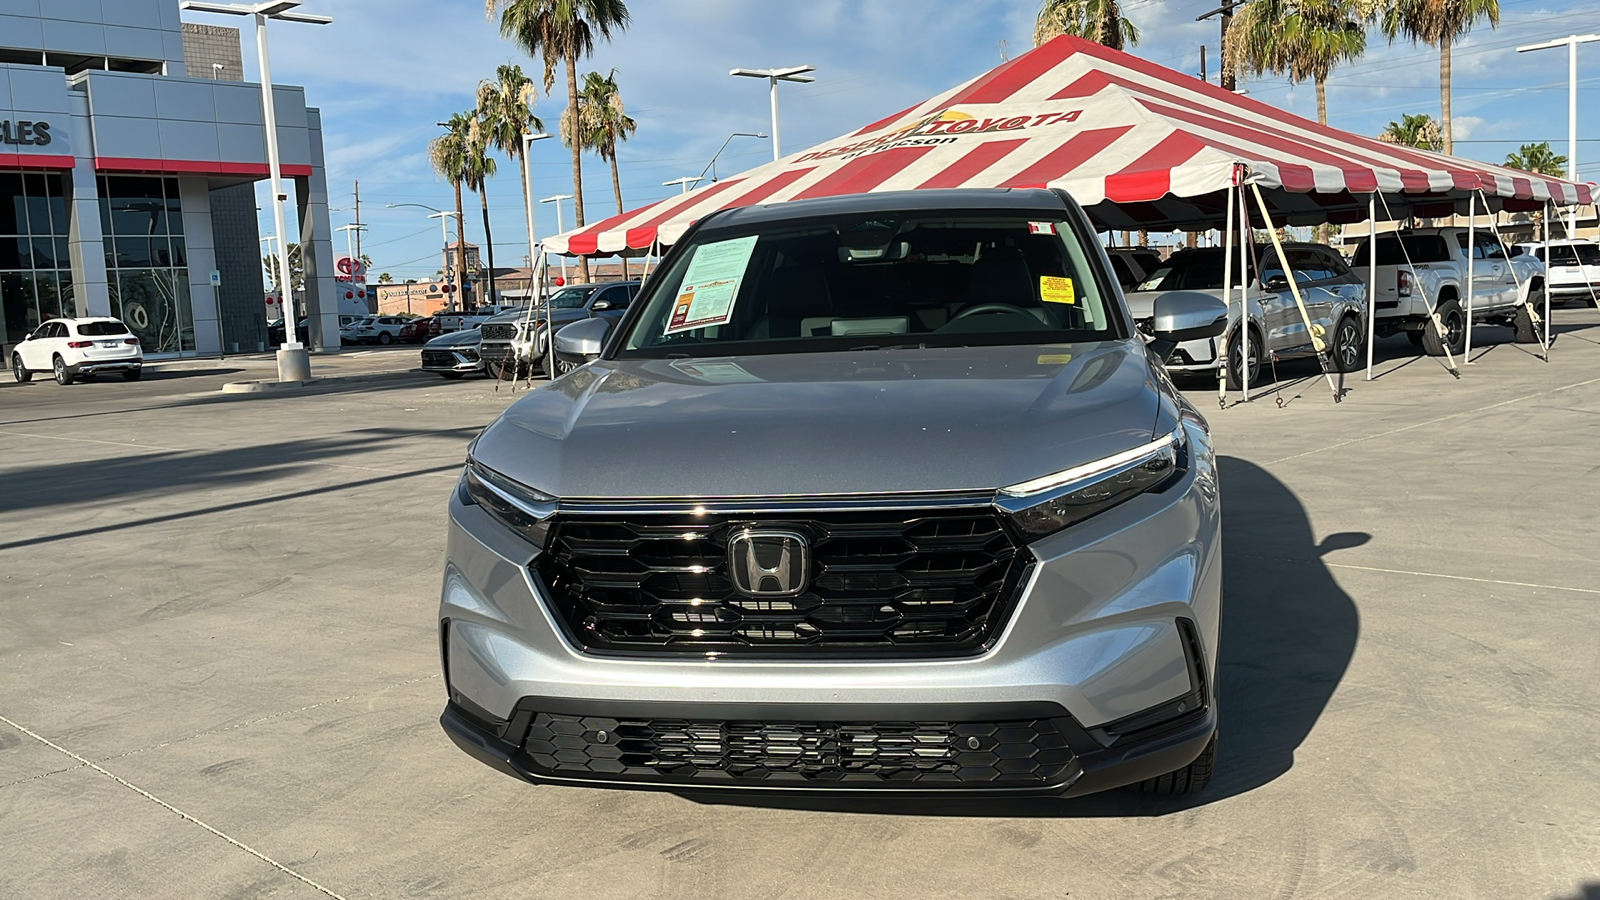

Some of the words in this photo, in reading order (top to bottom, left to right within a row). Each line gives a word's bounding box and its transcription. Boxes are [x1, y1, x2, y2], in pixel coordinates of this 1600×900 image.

[0, 120, 51, 146] LES
[789, 127, 914, 164] DESERT
[925, 110, 1084, 134] TOYOTA
[872, 137, 958, 153] Tucson
